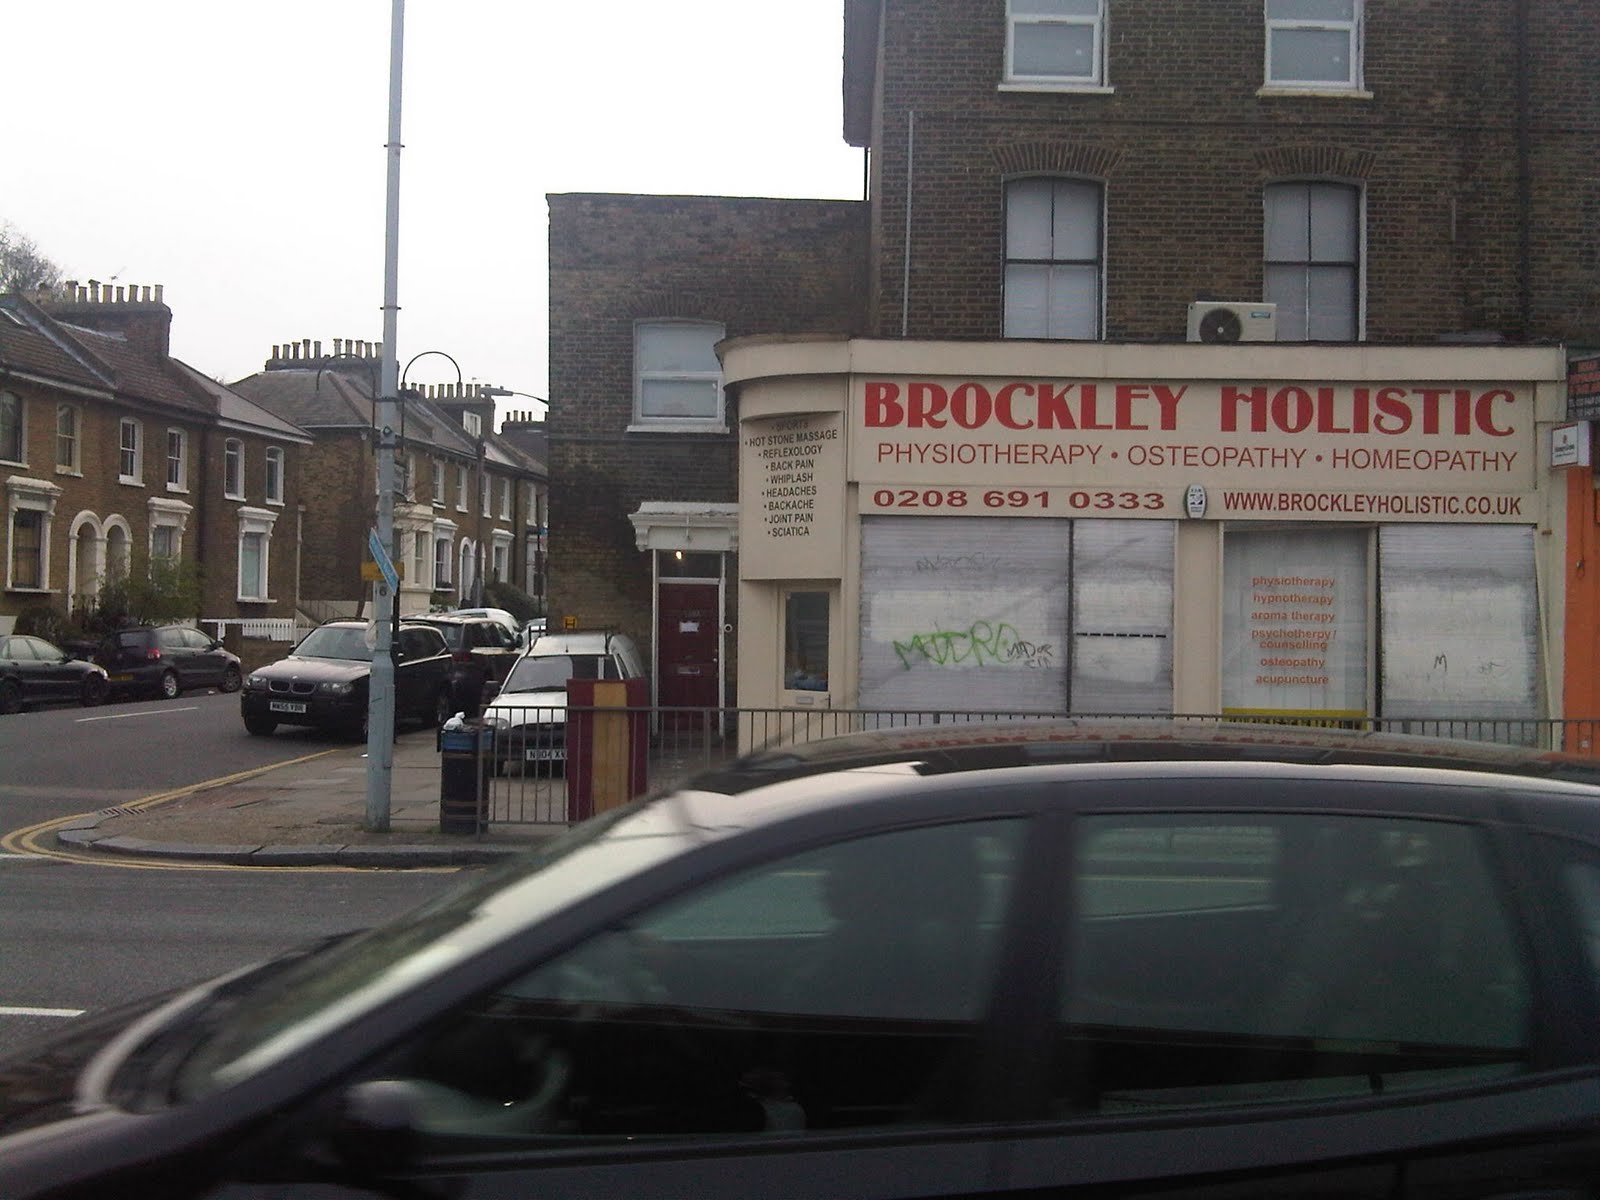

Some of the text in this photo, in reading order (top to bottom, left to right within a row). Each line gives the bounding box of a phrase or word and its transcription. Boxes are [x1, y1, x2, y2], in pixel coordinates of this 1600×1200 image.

[864, 381, 1516, 437] BROCKLEY HOLISTIC
[749, 429, 838, 447] HOT STONE MASSAGE
[763, 445, 823, 459] REFLEXOLOGY
[877, 442, 1518, 472] PHYSIOTHERAPY OSTEOPATHY HOMEOPATHY
[770, 459, 814, 471] BACK PAIN
[770, 472, 813, 484] WHIPLASH
[766, 486, 817, 498] HEADACHES
[768, 499, 814, 511] BACKACHE
[873, 489, 1165, 510] 0208 691 0333
[1223, 491, 1521, 516] WWW.BROCKLEYHOLISTIC.CO.UK
[794, 513, 814, 523] PAIN
[772, 526, 810, 537] SCIATICA
[1252, 575, 1336, 588] physiotherapy
[1253, 593, 1334, 606] hypnotherapy
[1251, 611, 1336, 624] aroma therapy
[1260, 657, 1326, 669] osteopathy
[1255, 675, 1329, 687] acupuncture
